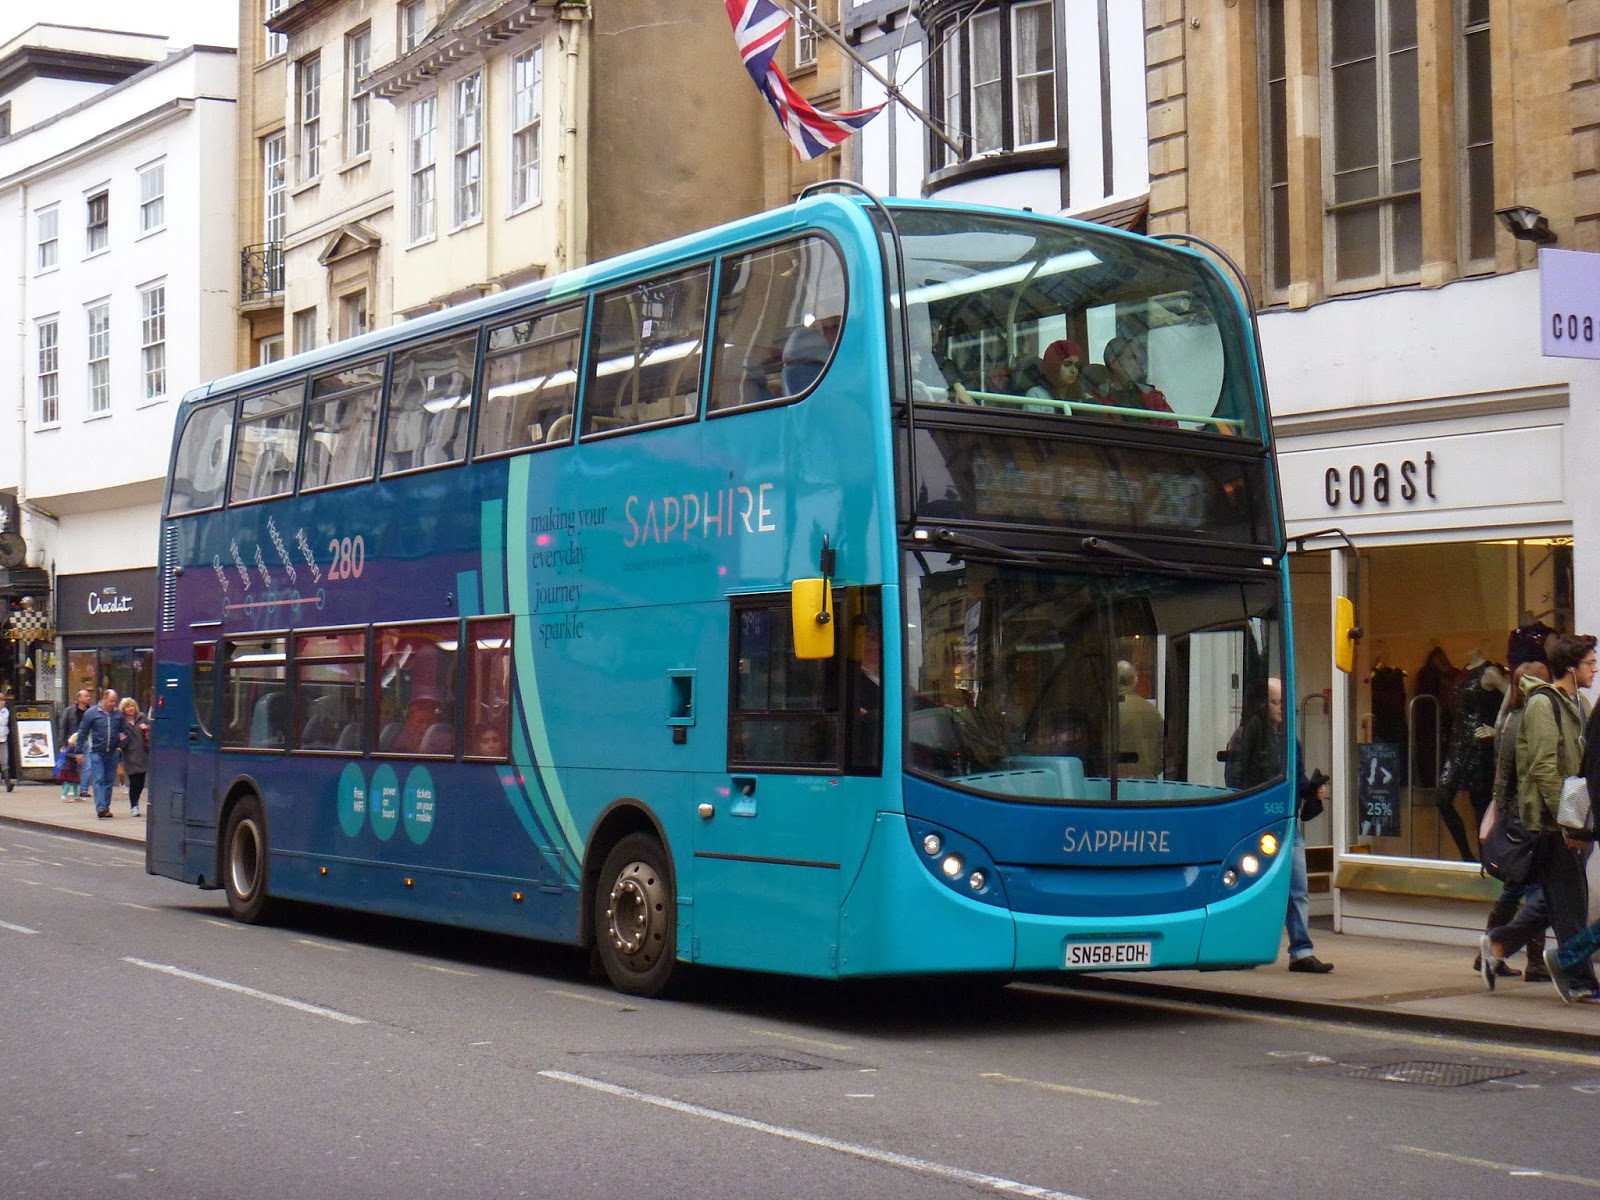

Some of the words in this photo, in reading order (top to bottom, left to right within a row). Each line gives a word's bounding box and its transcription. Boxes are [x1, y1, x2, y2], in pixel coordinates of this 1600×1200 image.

[1552, 313, 1600, 342] coa
[1324, 451, 1437, 507] coast
[531, 507, 576, 537] making
[578, 506, 608, 535] your
[624, 483, 776, 548] SAPPHIRE
[327, 534, 365, 581] 280
[532, 540, 587, 576] everyday
[533, 582, 584, 614] journey
[539, 614, 584, 649] sparkle
[1366, 802, 1393, 816] 25%
[1062, 827, 1170, 853] SAPPHIRE
[1072, 946, 1112, 965] SN58
[1116, 944, 1146, 963] EOH
